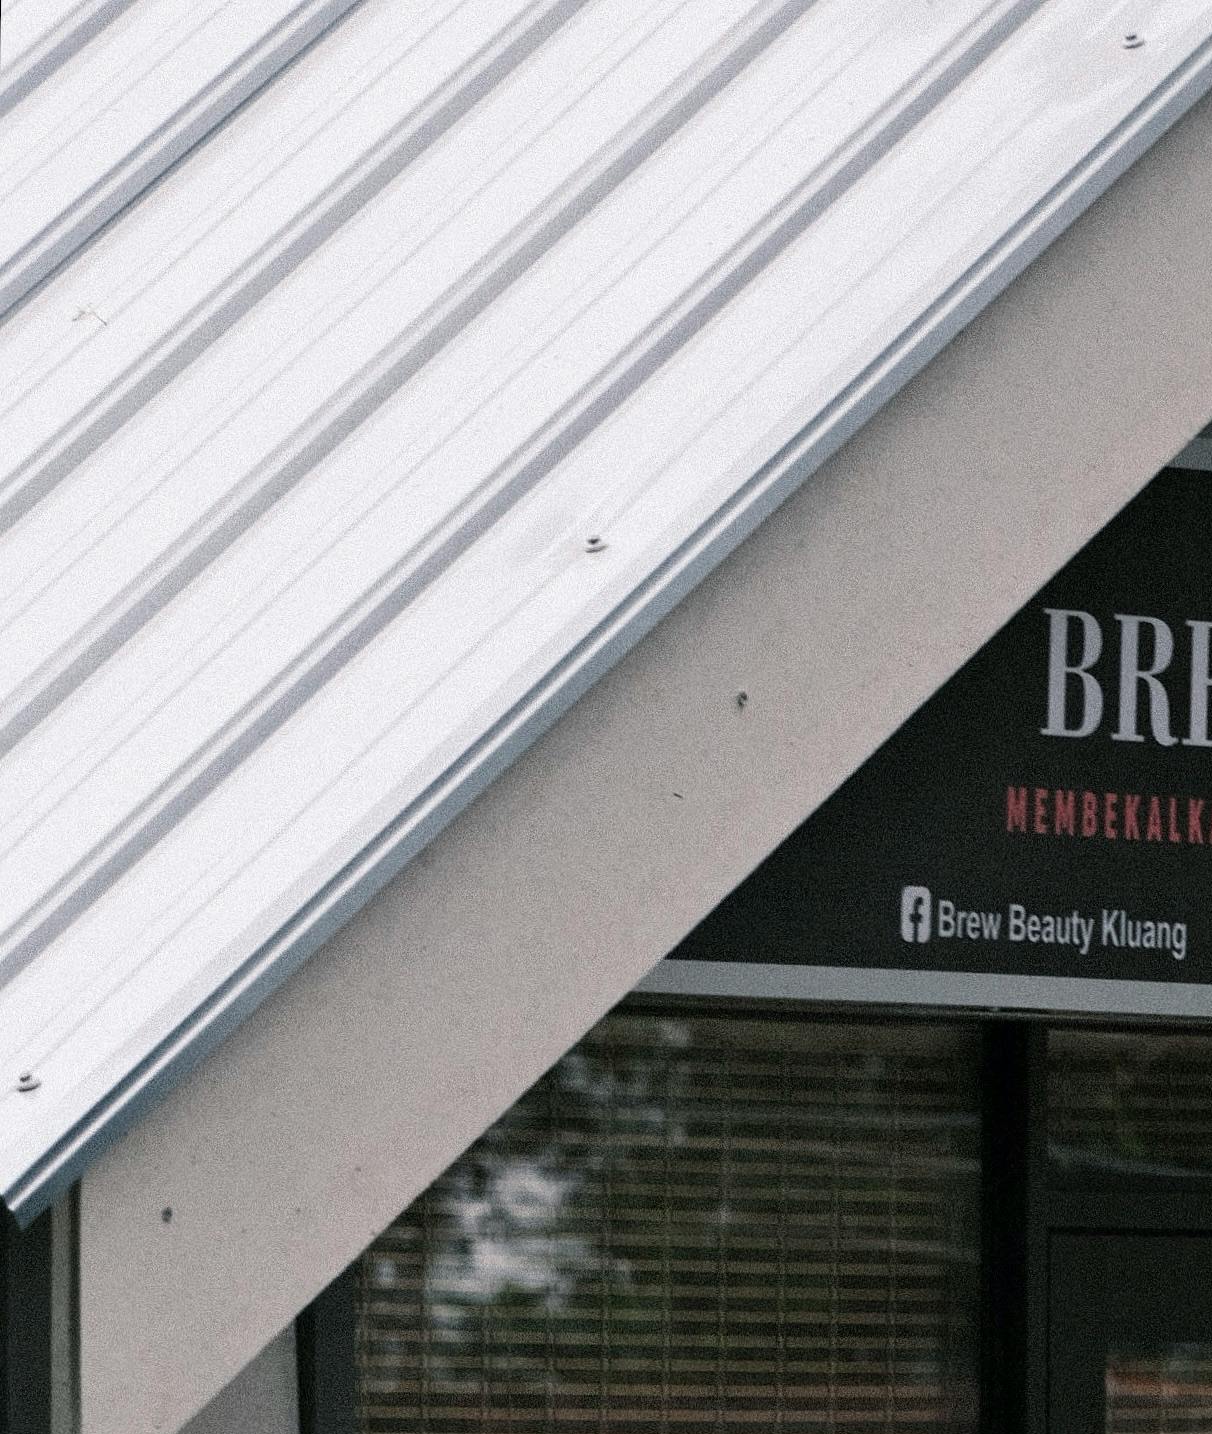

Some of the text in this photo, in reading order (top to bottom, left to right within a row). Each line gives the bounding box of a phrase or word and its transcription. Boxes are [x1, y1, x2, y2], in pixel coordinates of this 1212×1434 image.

[938, 900, 1187, 960] Brew Beauty Kluang
